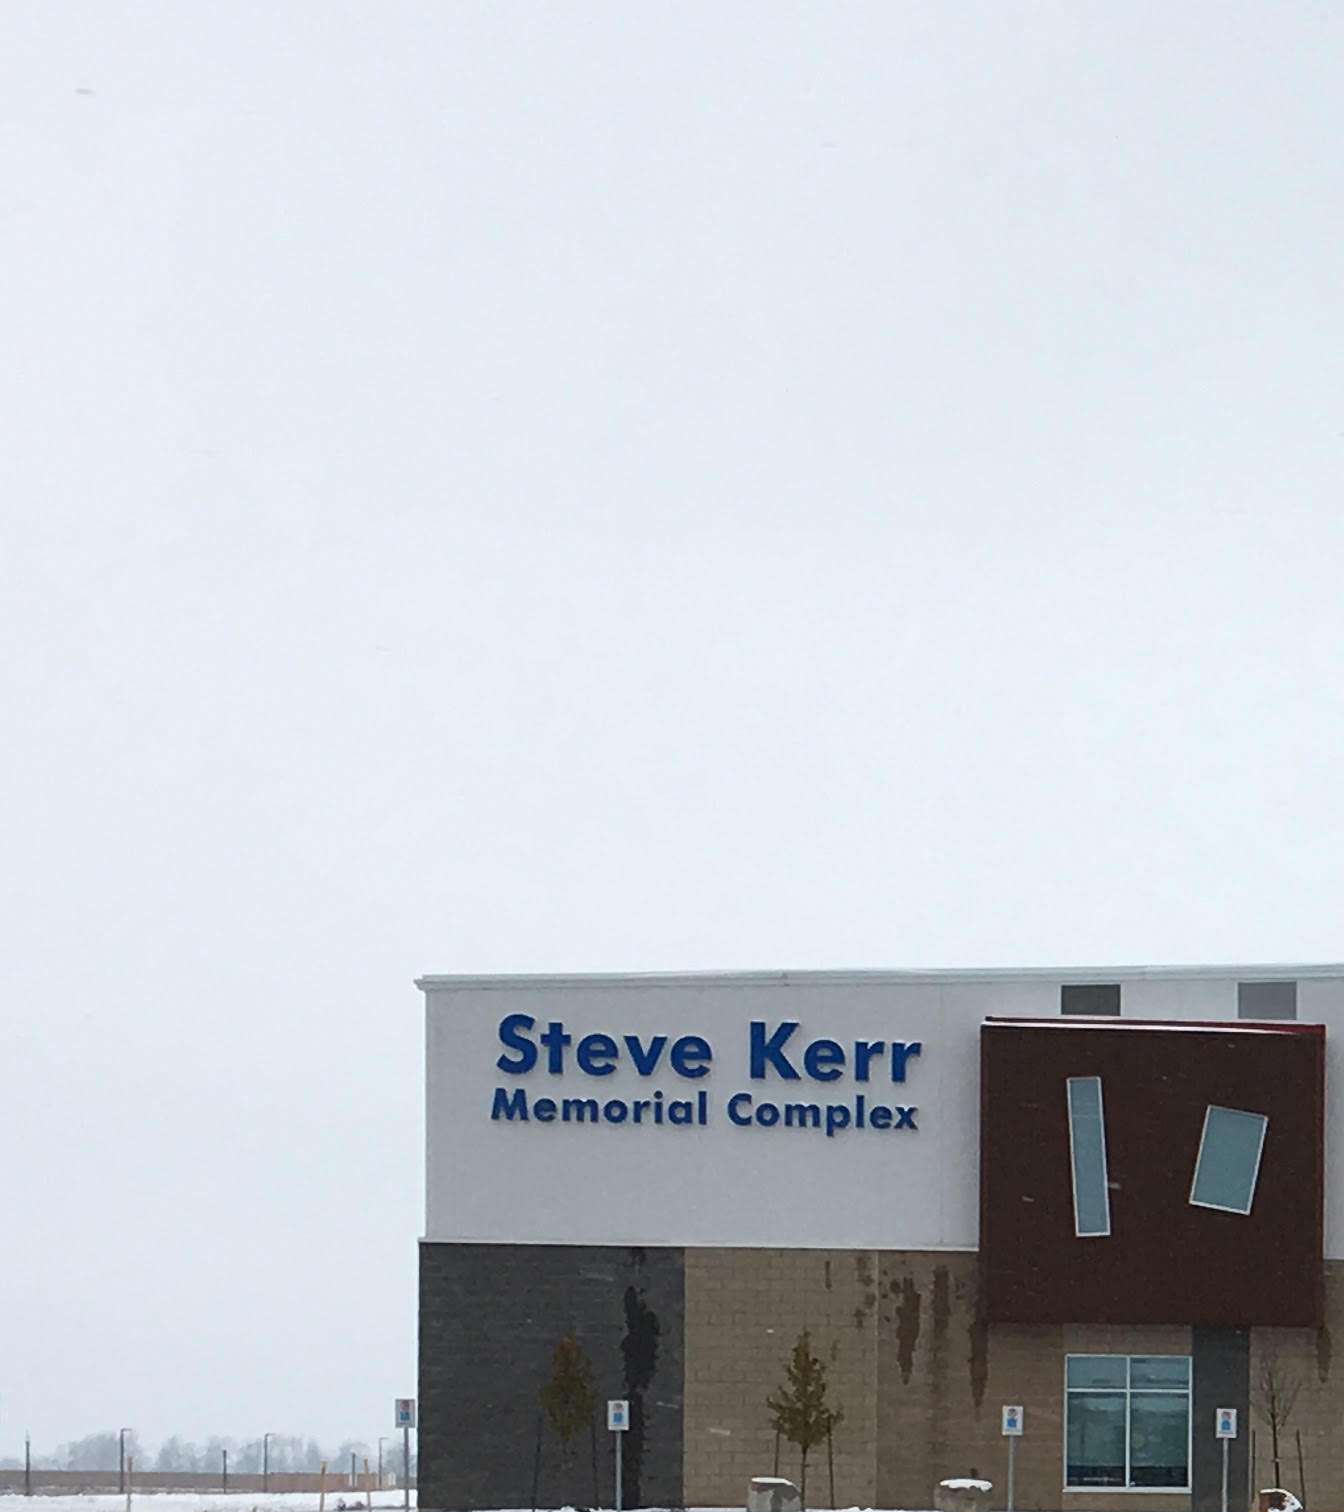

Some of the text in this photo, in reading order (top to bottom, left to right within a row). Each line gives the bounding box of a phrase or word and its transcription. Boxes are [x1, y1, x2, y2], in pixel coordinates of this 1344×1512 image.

[496, 1013, 922, 1083] Steve Kerr
[491, 1088, 919, 1136] Memorial Complex
